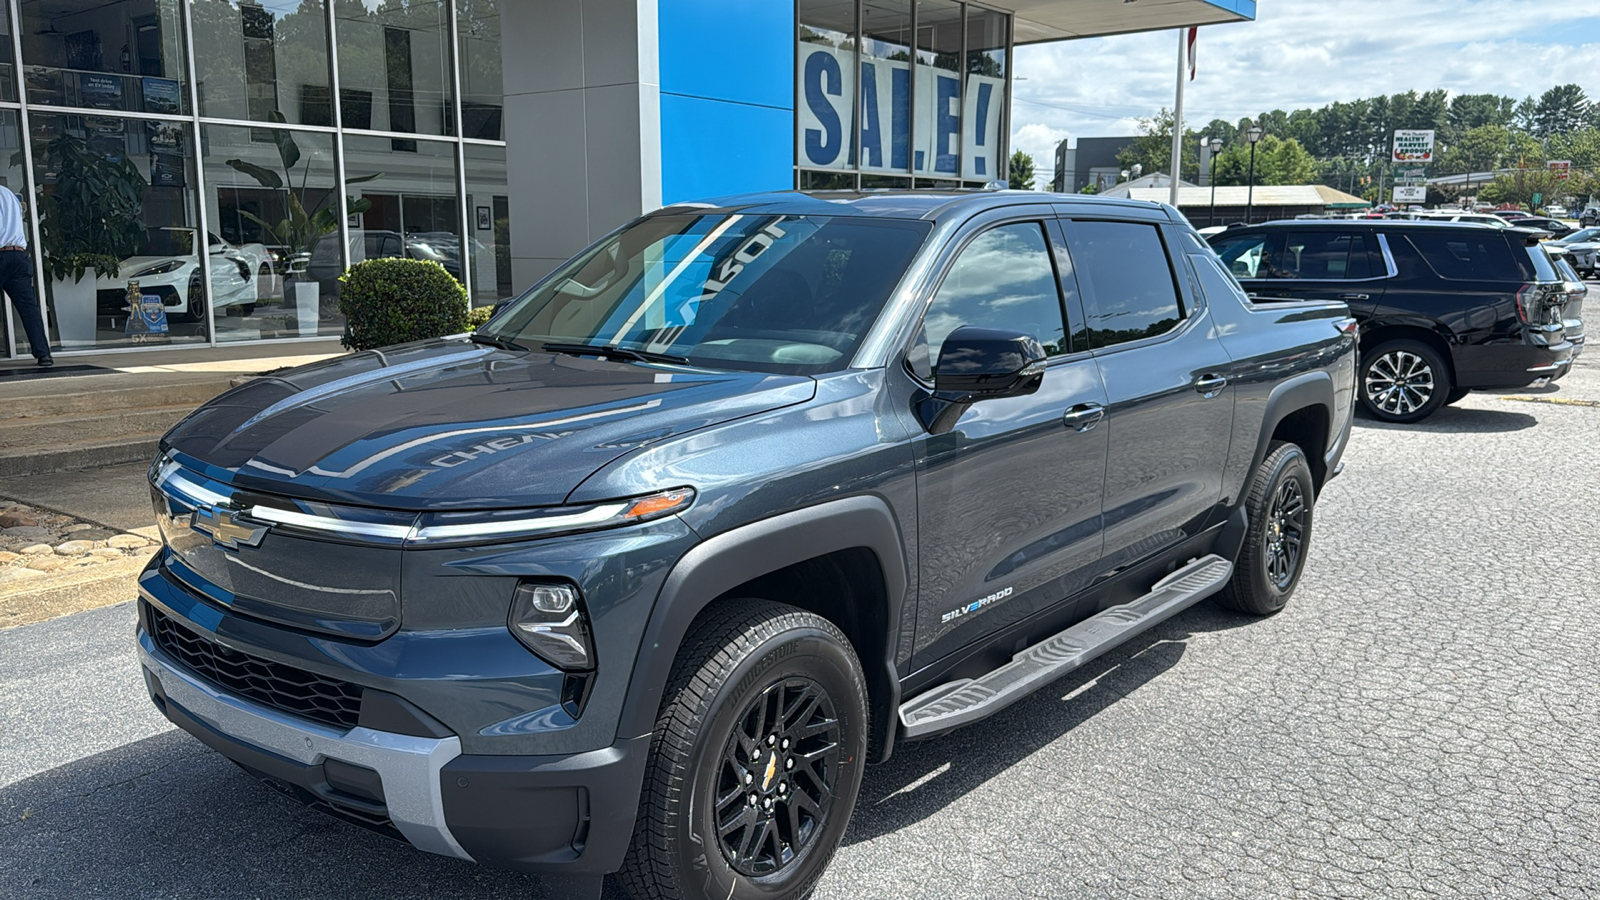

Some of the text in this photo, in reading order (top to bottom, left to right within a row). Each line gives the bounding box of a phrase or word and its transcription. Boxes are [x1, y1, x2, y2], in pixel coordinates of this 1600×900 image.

[804, 51, 993, 175] SALE!
[941, 586, 1013, 624] SILVERADO
[728, 638, 801, 709] BRIDGESTONE
